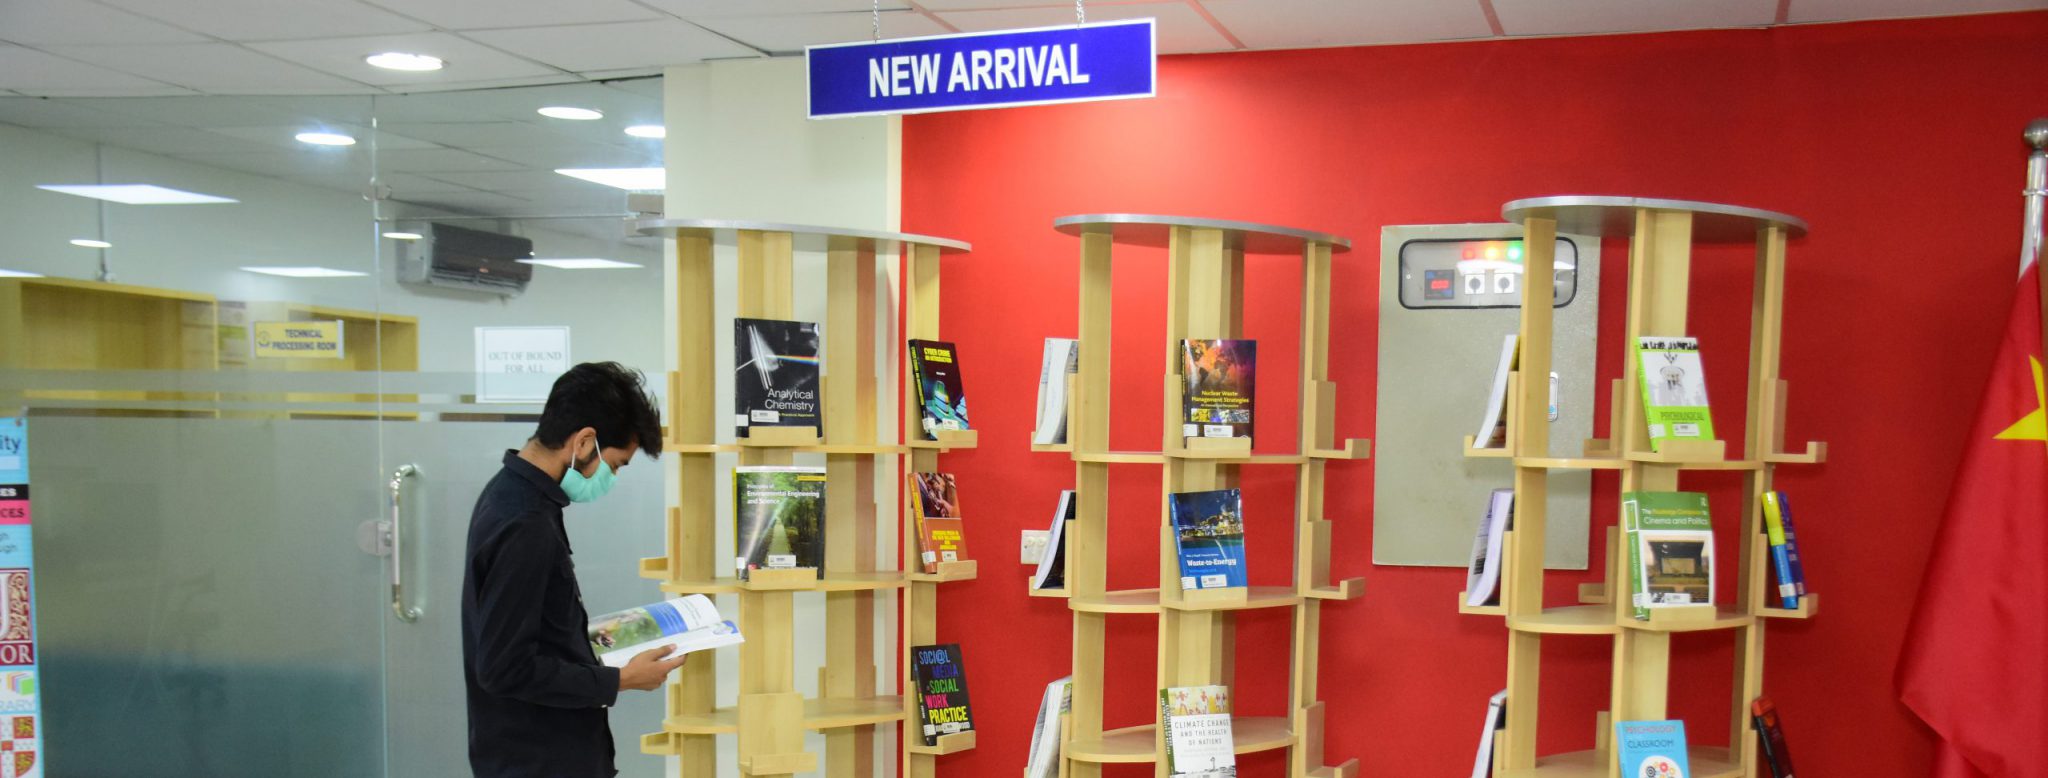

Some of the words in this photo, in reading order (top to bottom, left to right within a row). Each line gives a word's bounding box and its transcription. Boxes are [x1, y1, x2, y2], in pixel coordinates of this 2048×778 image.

[869, 53, 941, 98] NEW
[947, 43, 1090, 92] ARRIVAL
[285, 329, 323, 338] TECHNICAL
[272, 341, 315, 351] PROCESSING
[316, 341, 337, 351] ROOM
[488, 352, 509, 361] OUT
[511, 352, 524, 361] OF
[526, 352, 562, 361] BOUND
[505, 364, 524, 374] FOR
[527, 364, 545, 374] ALL
[767, 388, 814, 400] Analytical
[1191, 396, 1222, 404] Management
[764, 399, 815, 412] Chemistry
[1643, 517, 1671, 525] Cinema
[1672, 517, 1687, 525] and
[1, 644, 33, 663] OR
[918, 649, 951, 665] SOCI@L
[932, 664, 959, 679] MEDIA
[929, 678, 960, 694] SOCIAL
[925, 694, 949, 709] WORK
[928, 706, 969, 724] PRACTICE
[1174, 720, 1205, 729] CLIMATE
[1207, 718, 1230, 727] CHANGE
[1627, 739, 1674, 749] CLASSROOM
